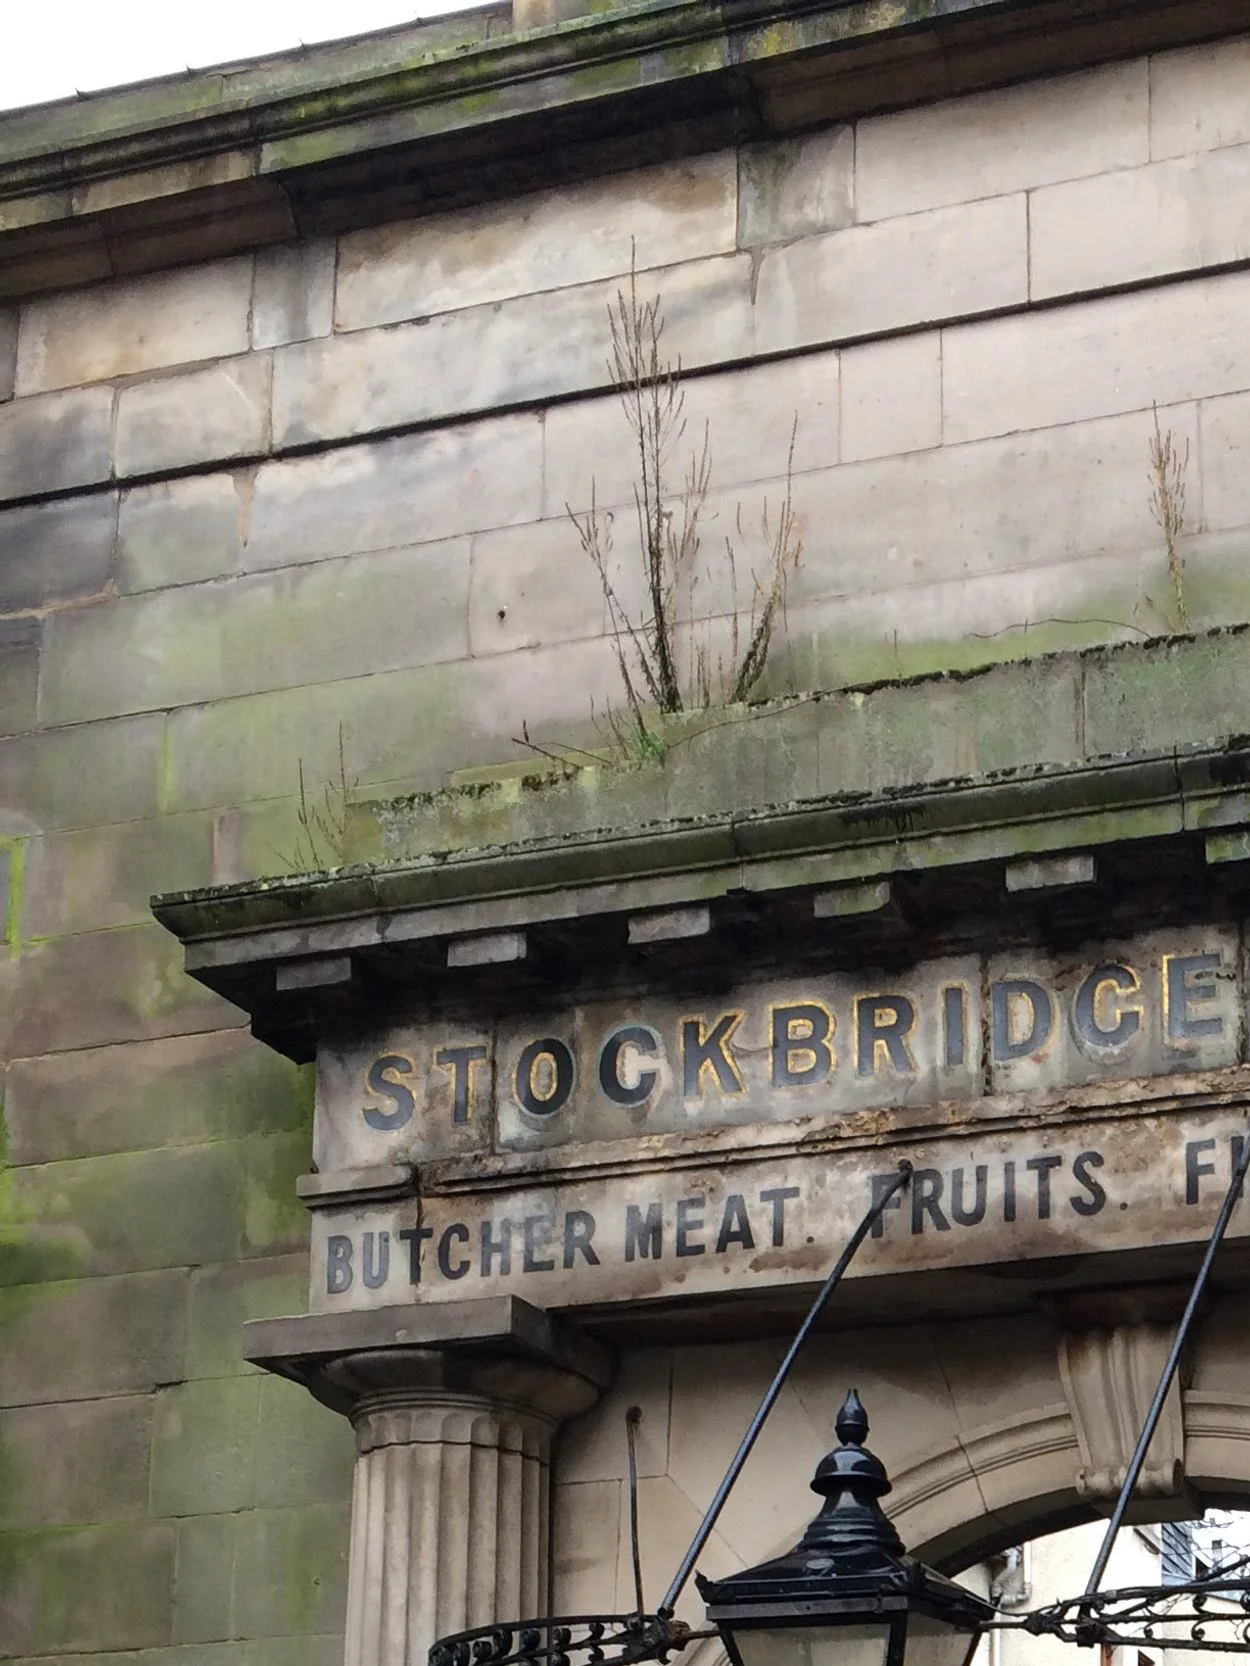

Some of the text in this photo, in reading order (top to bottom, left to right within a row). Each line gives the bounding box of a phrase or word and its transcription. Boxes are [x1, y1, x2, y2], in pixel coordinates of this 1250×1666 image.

[361, 949, 1226, 1132] STOCKBRIDGE
[326, 1210, 601, 1294] BUTCHER
[624, 1186, 815, 1262] MEAT.
[870, 1150, 1128, 1239] FRUITS.
